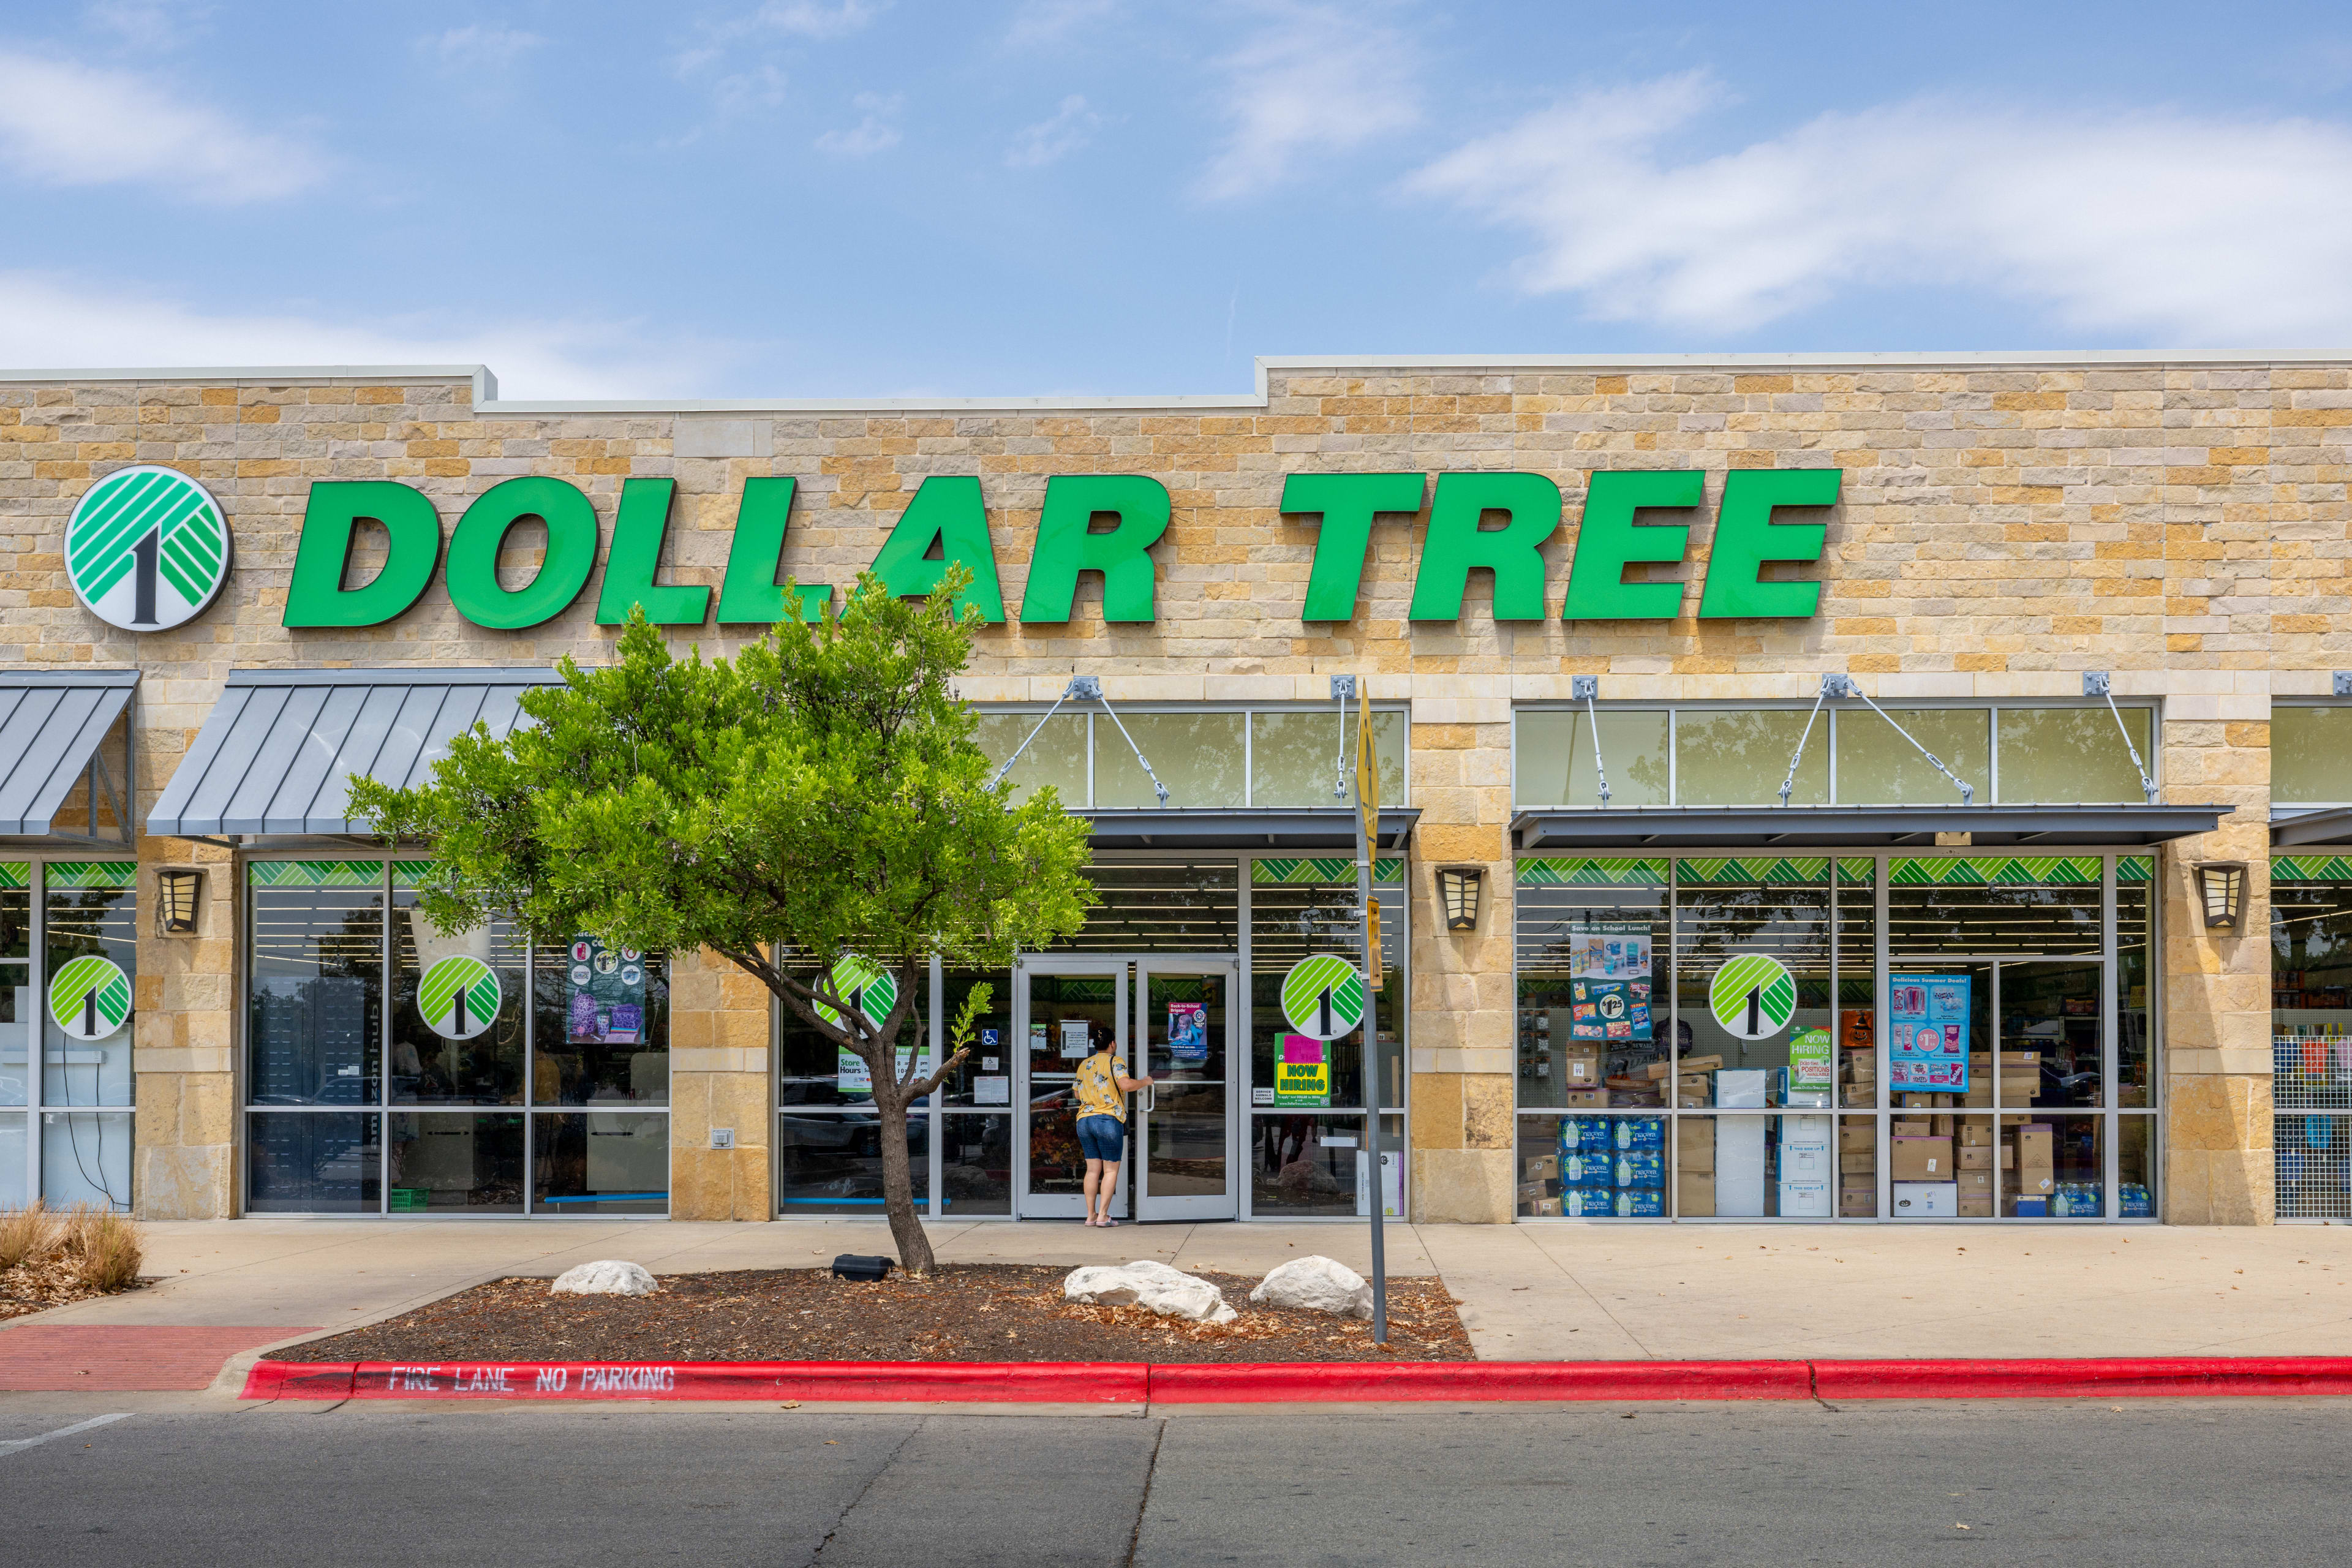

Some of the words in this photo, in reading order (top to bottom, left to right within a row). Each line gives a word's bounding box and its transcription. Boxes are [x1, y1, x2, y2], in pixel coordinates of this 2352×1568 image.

[282, 475, 1171, 630] DOLLAR
[1280, 469, 1843, 622] TREE
[129, 525, 161, 625] 1
[81, 985, 97, 1036] 1
[369, 1004, 379, 1054] hub
[451, 984, 468, 1035] 1
[1316, 984, 1333, 1036] 1
[1744, 984, 1760, 1036] 1
[1792, 1044, 1830, 1054] HIRING
[1804, 1035, 1830, 1044] NOW
[1280, 1079, 1325, 1091] HIRING
[1287, 1065, 1319, 1077] NOW
[388, 1366, 440, 1391] FIRE
[453, 1366, 515, 1392] LANE
[535, 1367, 567, 1392] NO
[579, 1366, 675, 1392] PARKING
